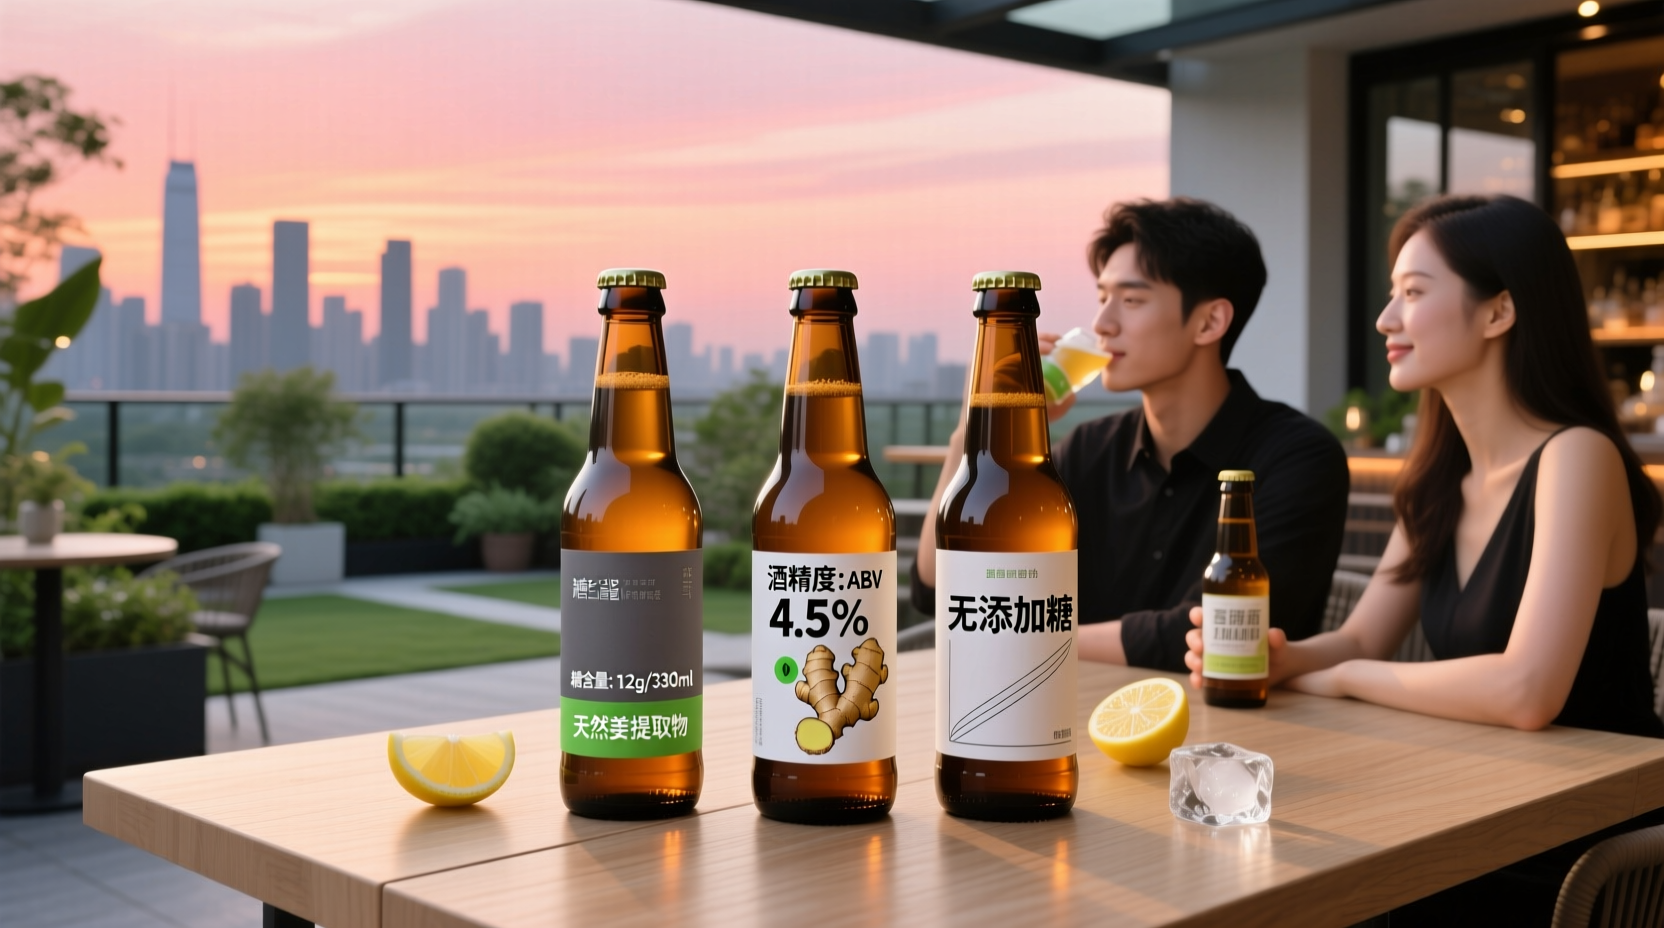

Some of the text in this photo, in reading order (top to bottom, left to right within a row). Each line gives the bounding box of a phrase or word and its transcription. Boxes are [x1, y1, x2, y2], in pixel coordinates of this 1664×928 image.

[769, 598, 869, 639] 4.5%
[948, 593, 1073, 634] 无添加糖
[616, 669, 694, 694] 12g/330ml
